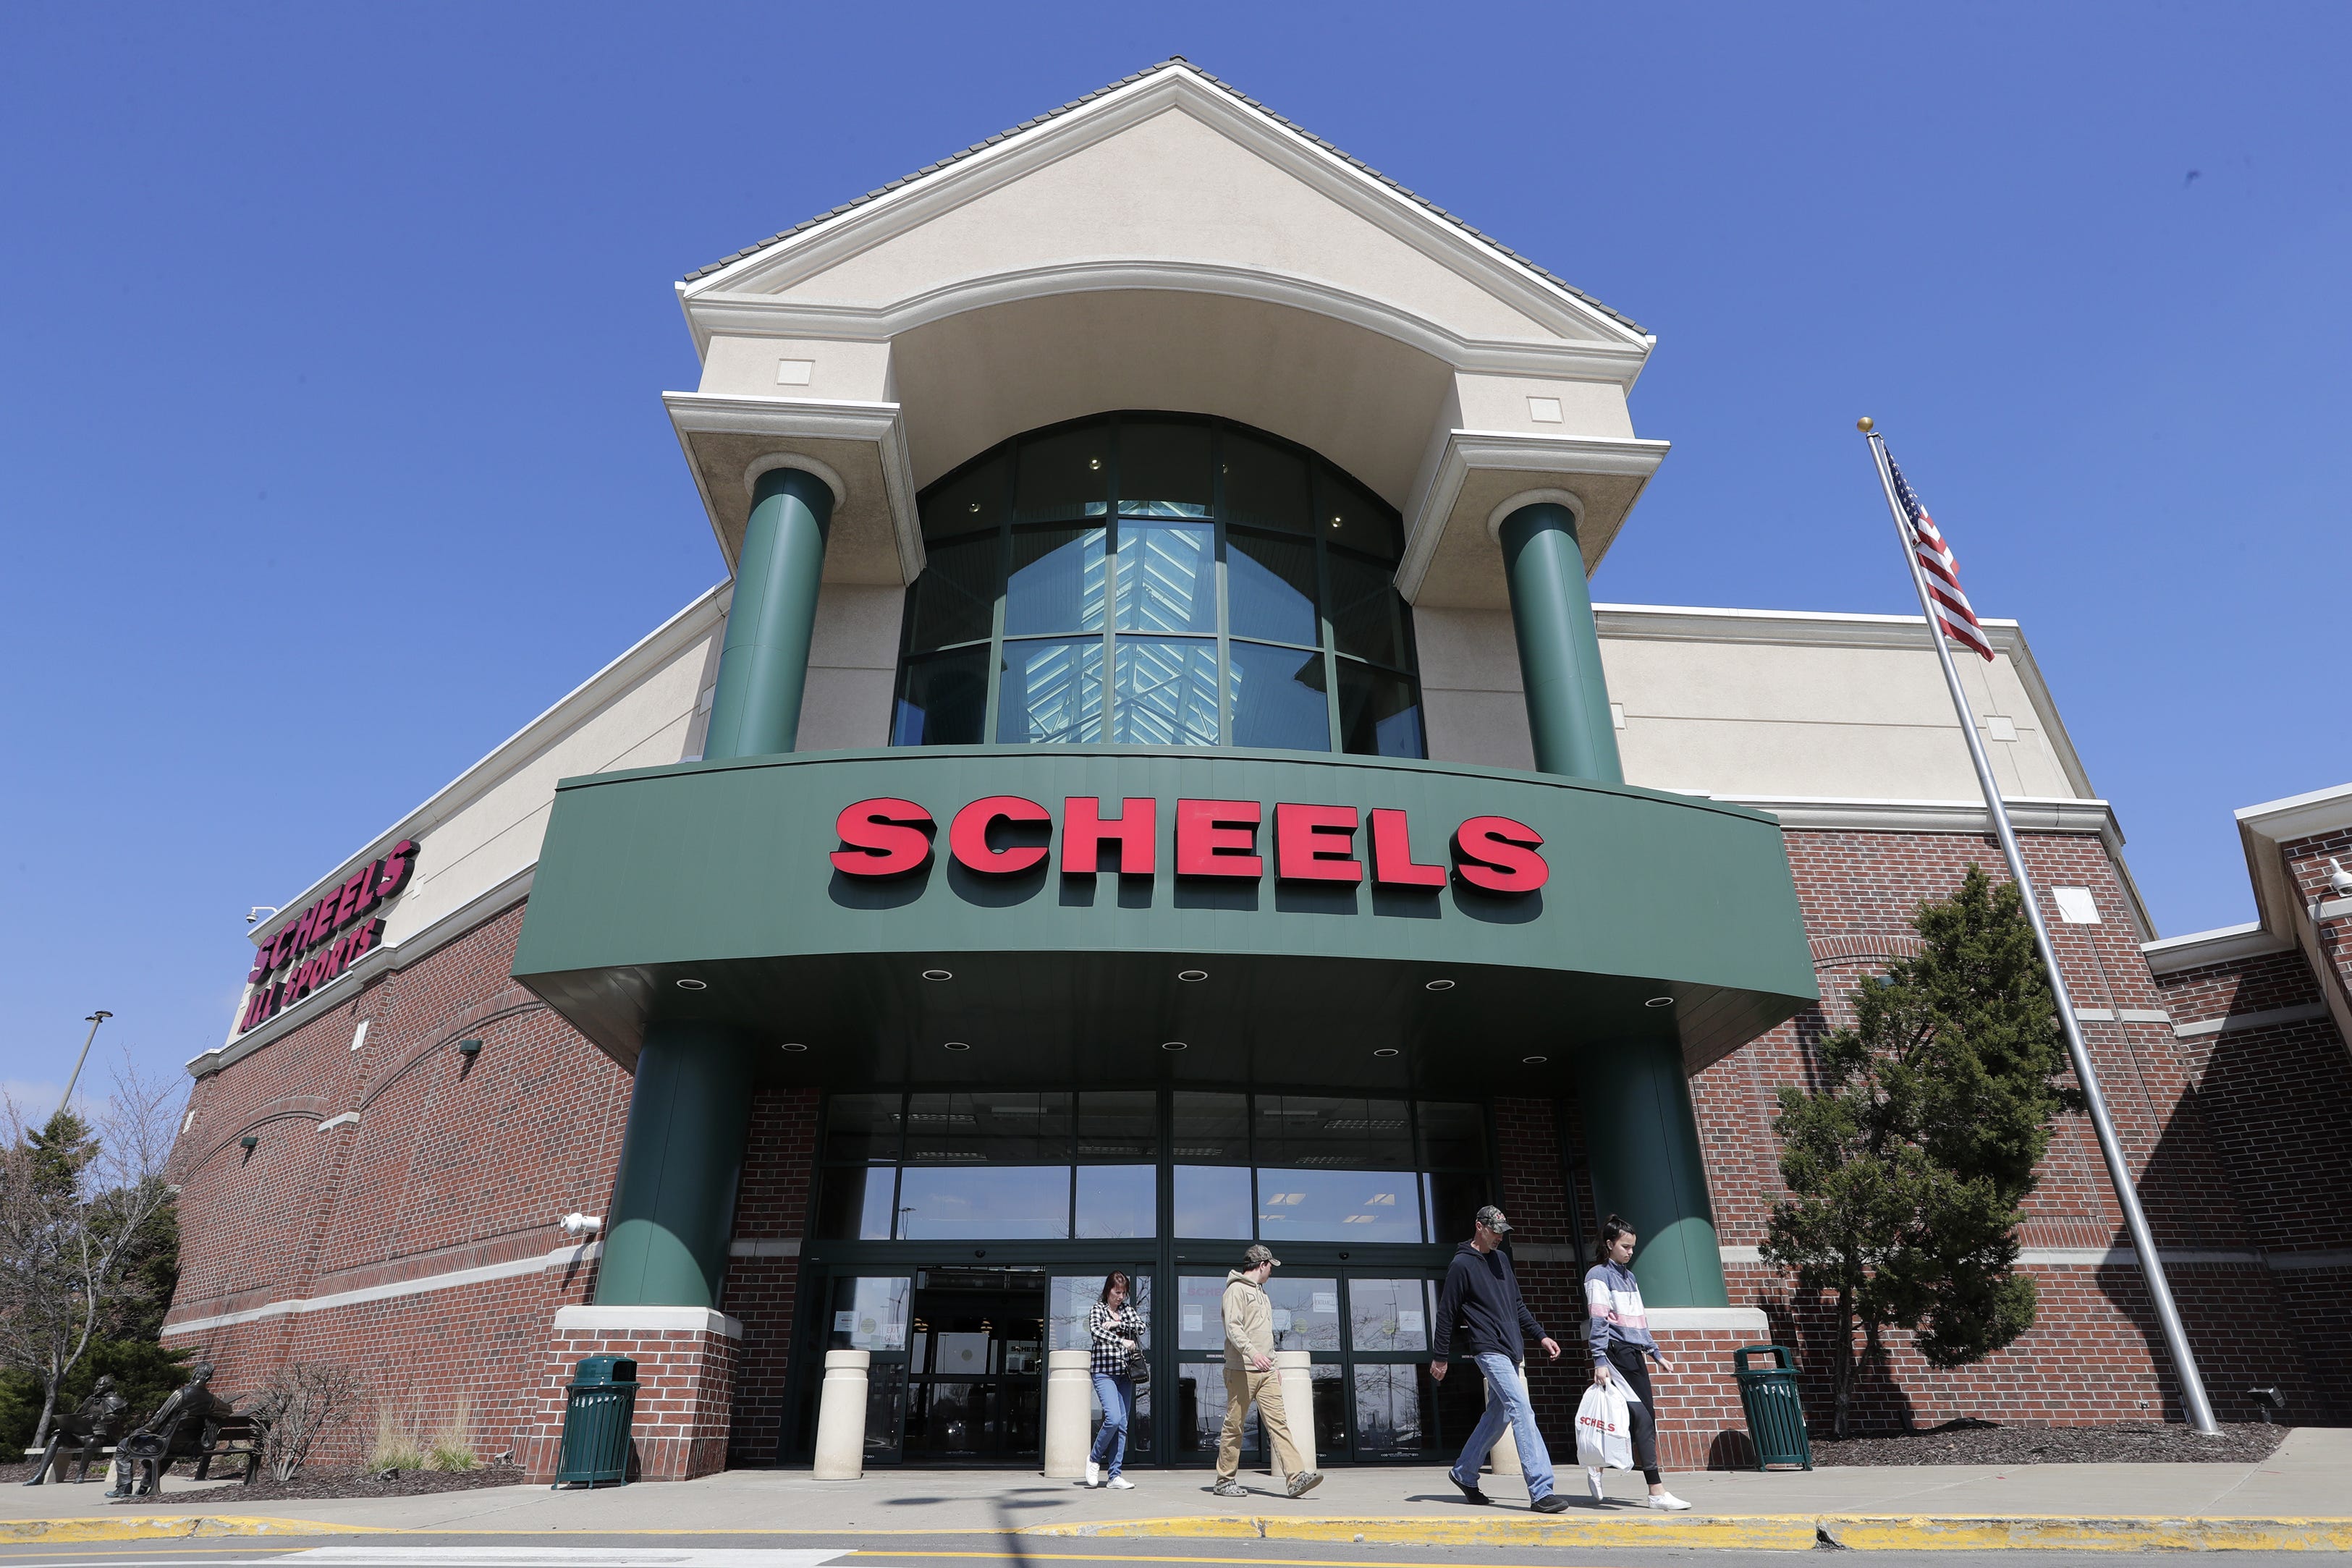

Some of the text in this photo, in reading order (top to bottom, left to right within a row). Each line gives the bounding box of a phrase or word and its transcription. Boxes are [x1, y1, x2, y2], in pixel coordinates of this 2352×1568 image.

[829, 794, 1549, 893] SCHEELS
[248, 839, 415, 984] SCHEELS
[237, 918, 379, 1035] ALL SPORTS
[1188, 1287, 1222, 1297] SCHE
